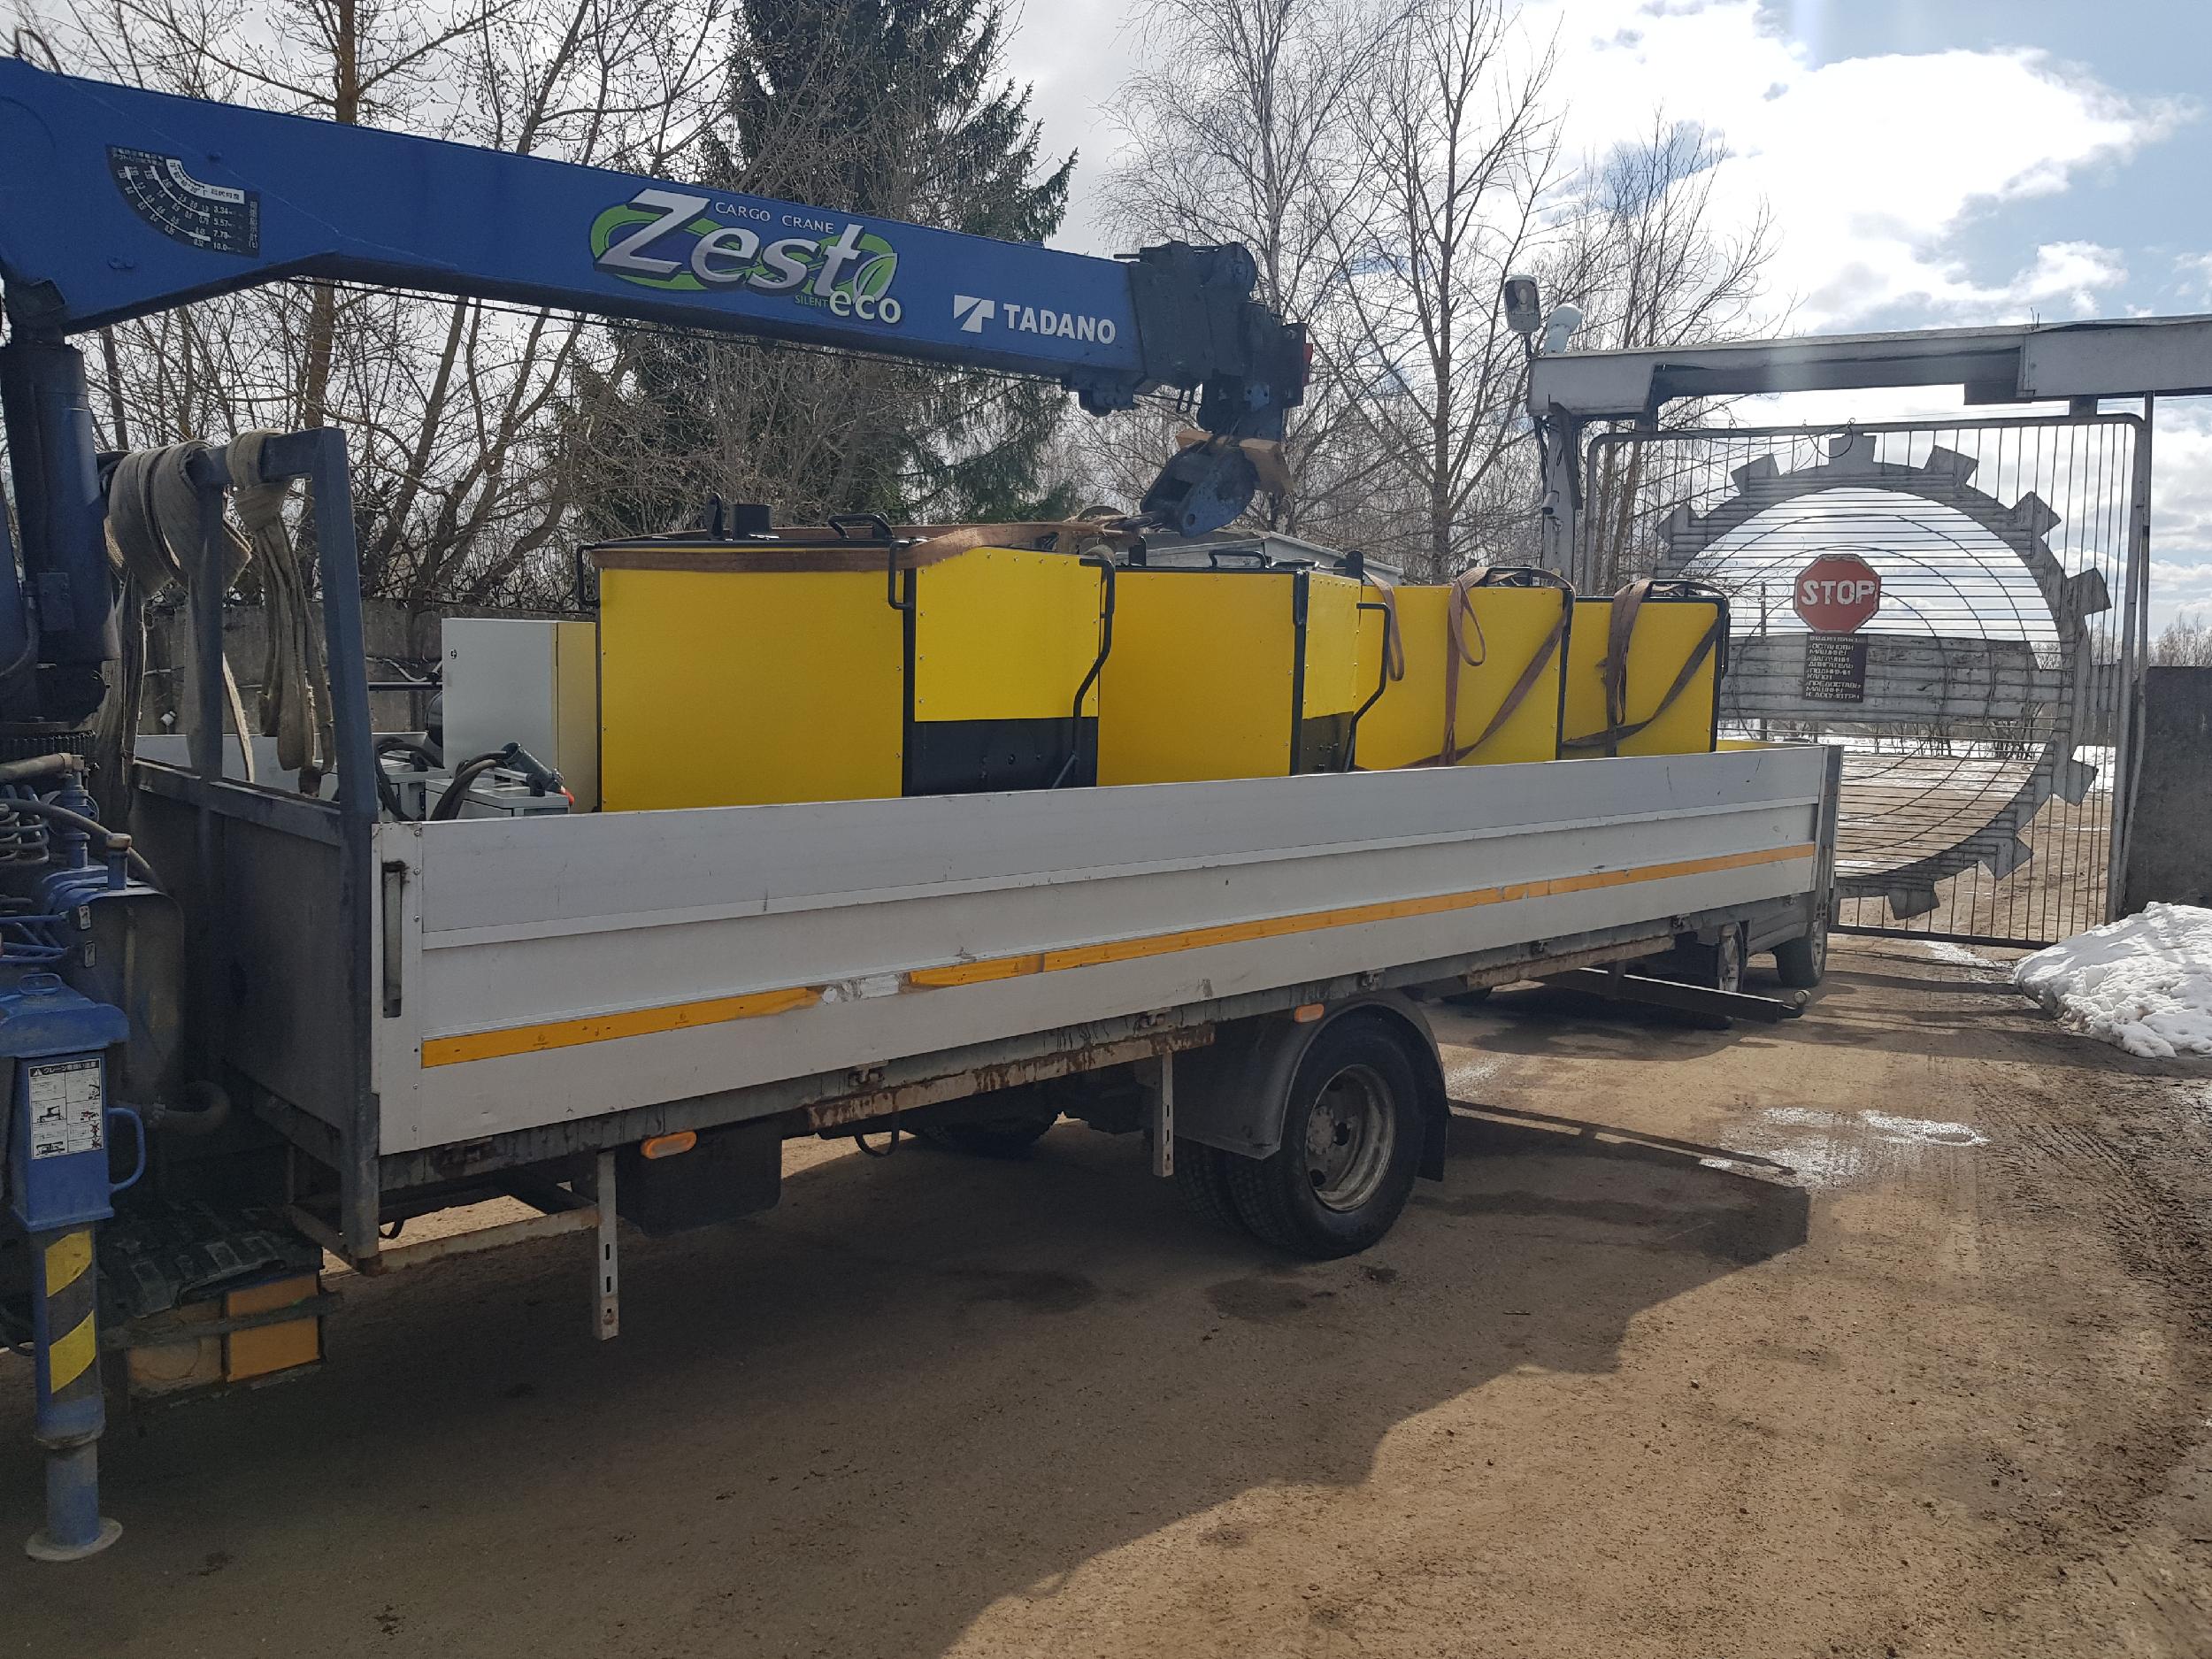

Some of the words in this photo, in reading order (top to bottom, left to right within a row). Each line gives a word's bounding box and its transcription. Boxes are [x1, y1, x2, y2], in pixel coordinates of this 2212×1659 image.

[715, 202, 771, 221] CARGO
[781, 215, 834, 234] CRANE
[595, 188, 864, 296] Zest
[795, 296, 829, 308] SILENT
[830, 291, 902, 324] eco
[1002, 303, 1117, 345] TADANO
[1801, 580, 1876, 605] STOP
